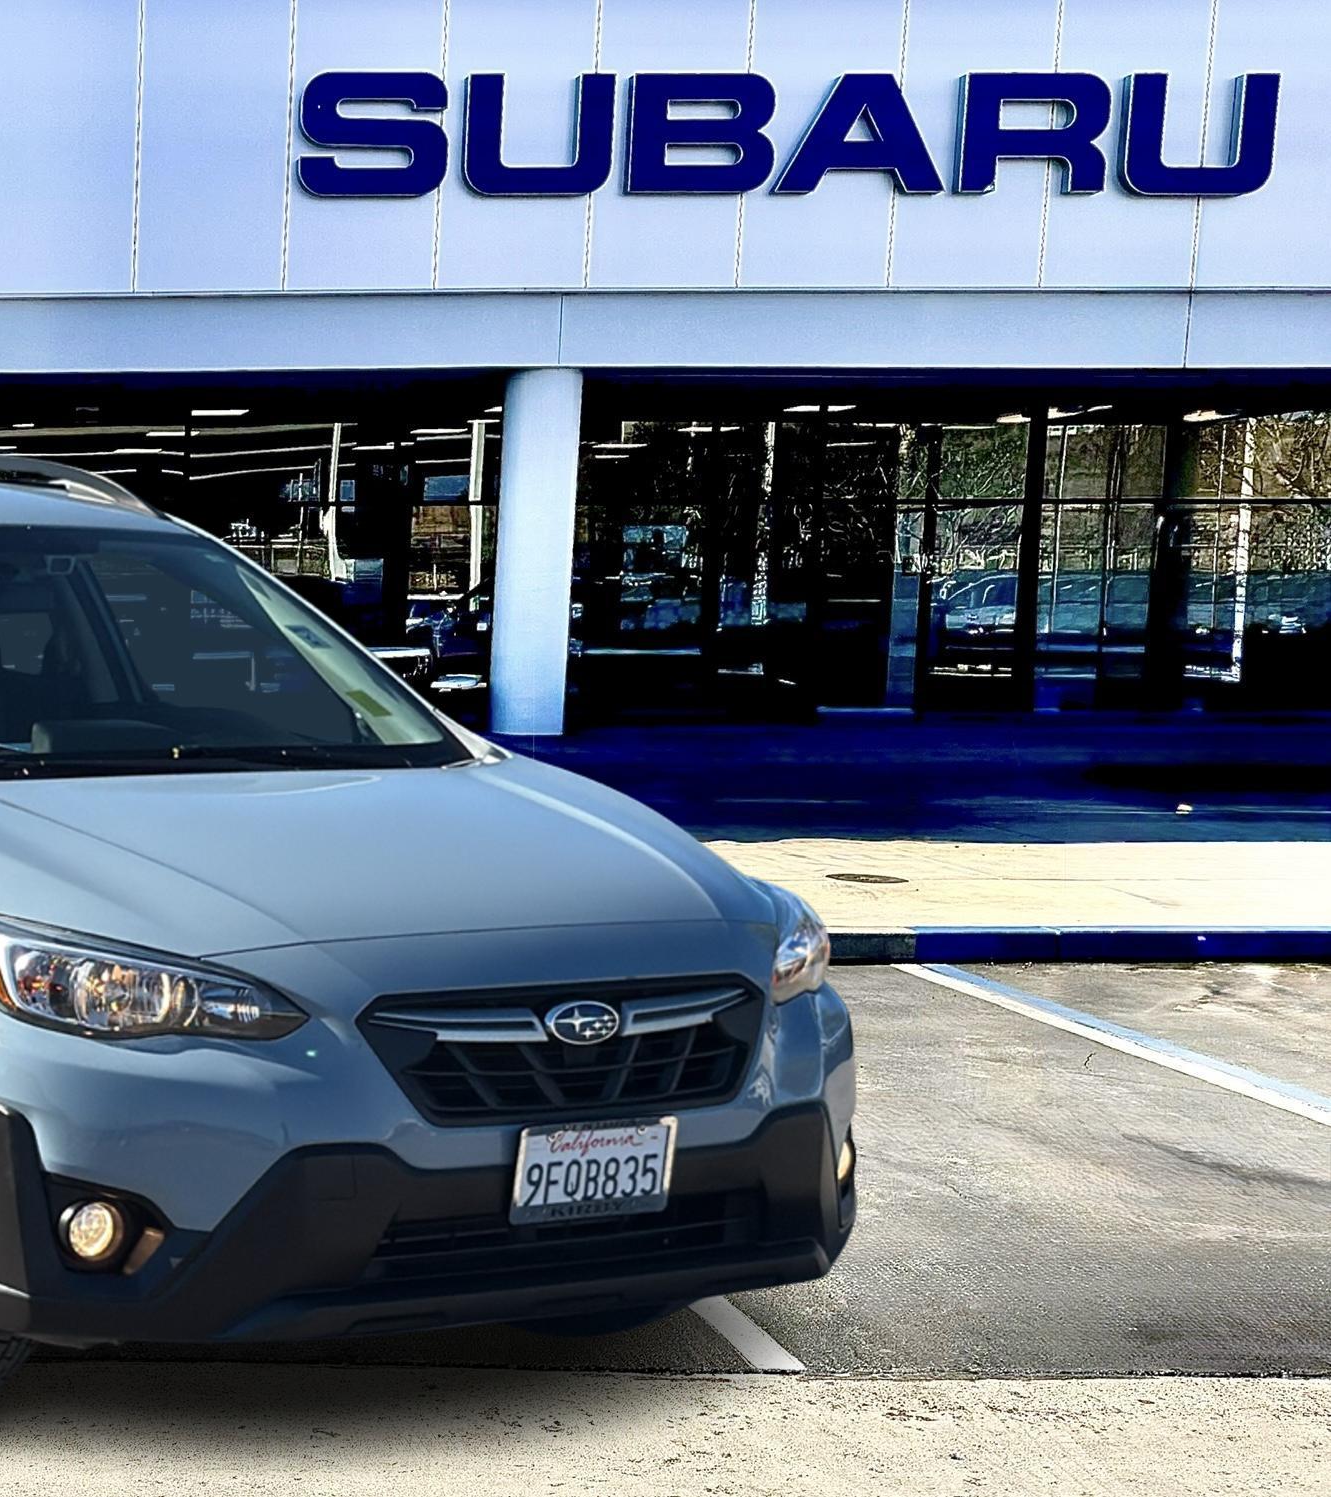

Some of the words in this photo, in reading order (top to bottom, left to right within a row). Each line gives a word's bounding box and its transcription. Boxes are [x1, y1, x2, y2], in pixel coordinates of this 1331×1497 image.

[297, 71, 1281, 197] SUBARU
[550, 1131, 643, 1156] California
[525, 1154, 657, 1205] 9FQB835
